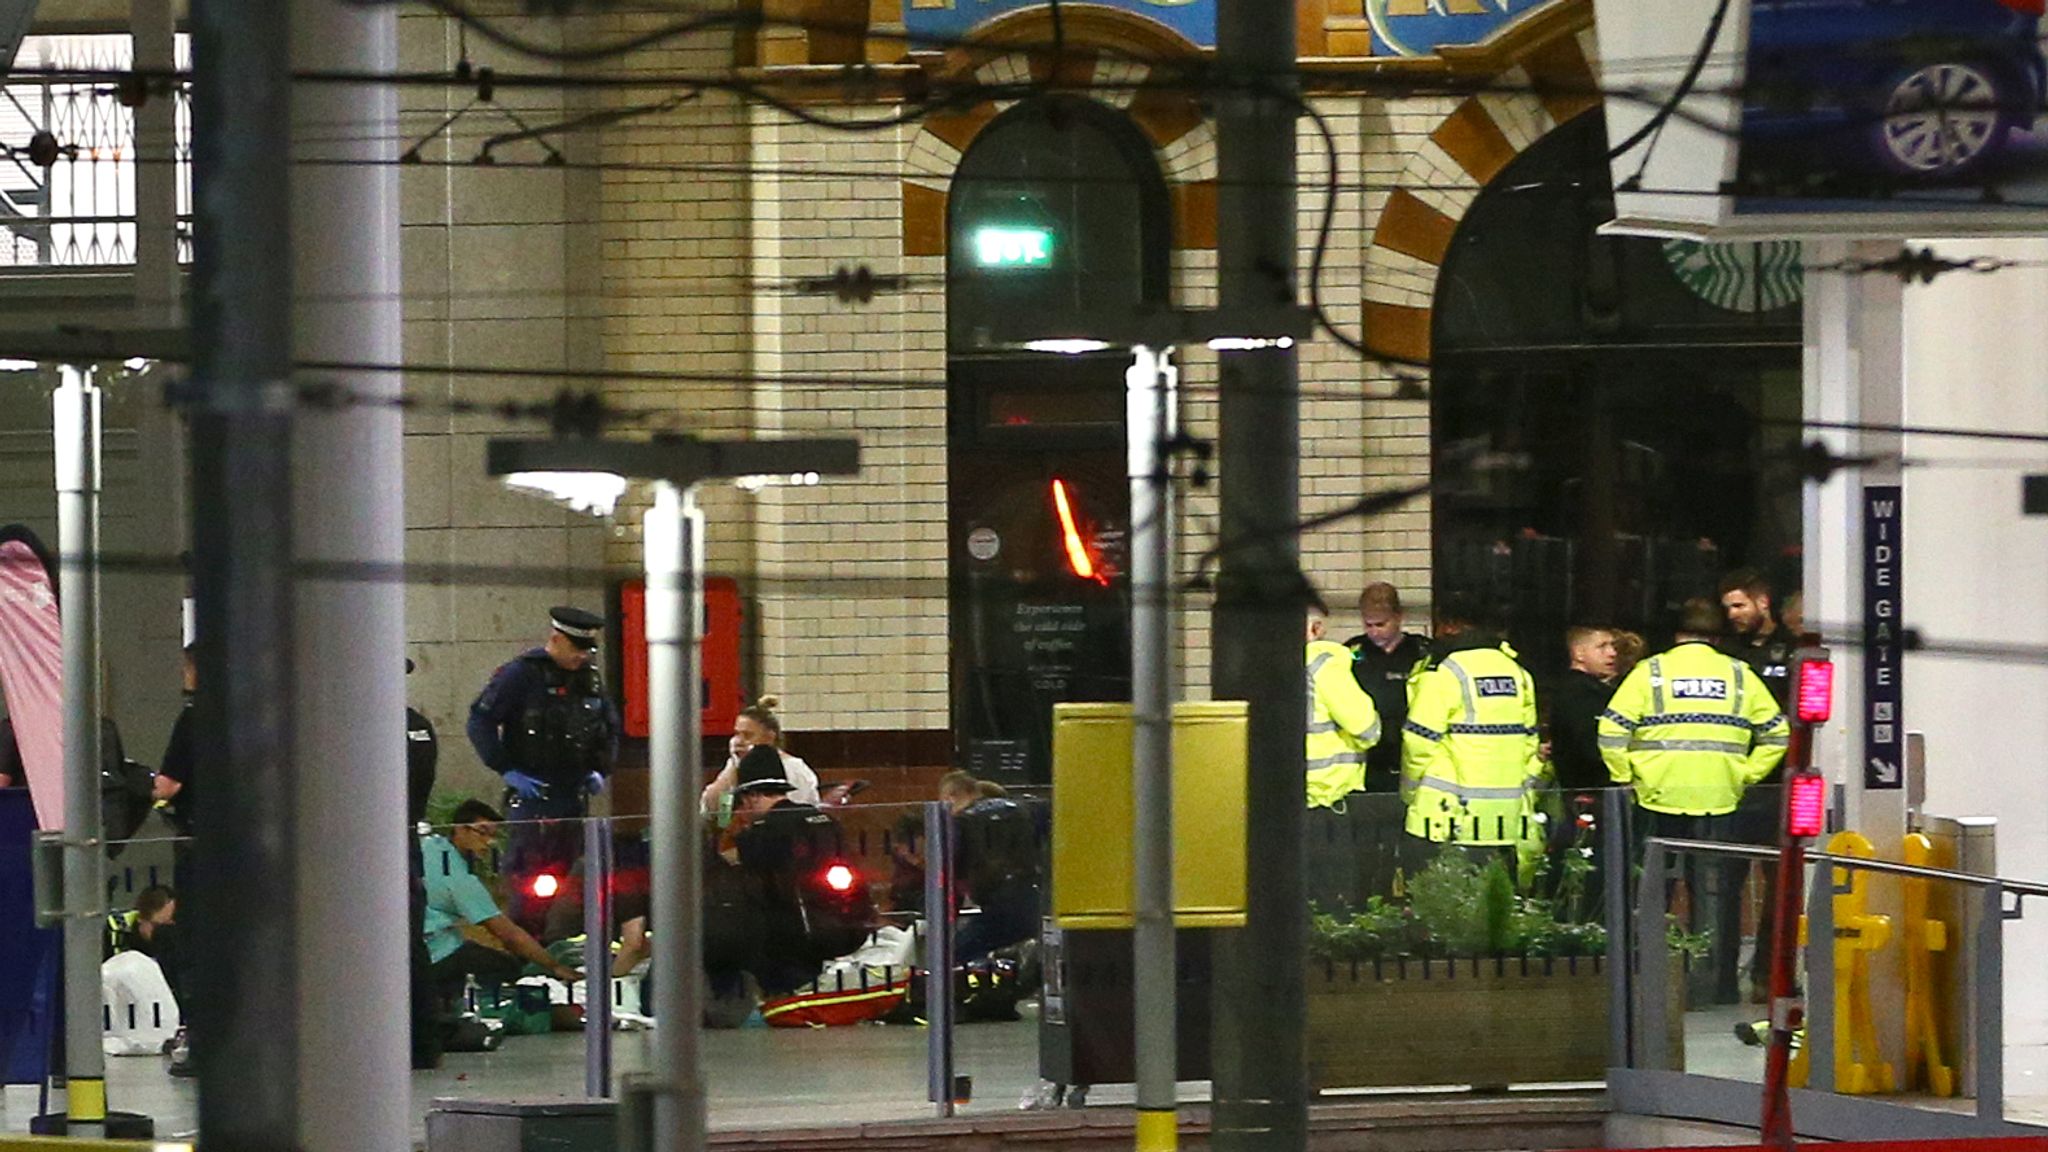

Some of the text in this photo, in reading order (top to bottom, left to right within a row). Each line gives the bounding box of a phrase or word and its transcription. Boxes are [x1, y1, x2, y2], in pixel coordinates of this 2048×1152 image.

[1872, 500, 1894, 686] WIDE GATE
[1475, 678, 1518, 694] POLICE
[1672, 680, 1727, 698] POLICE
